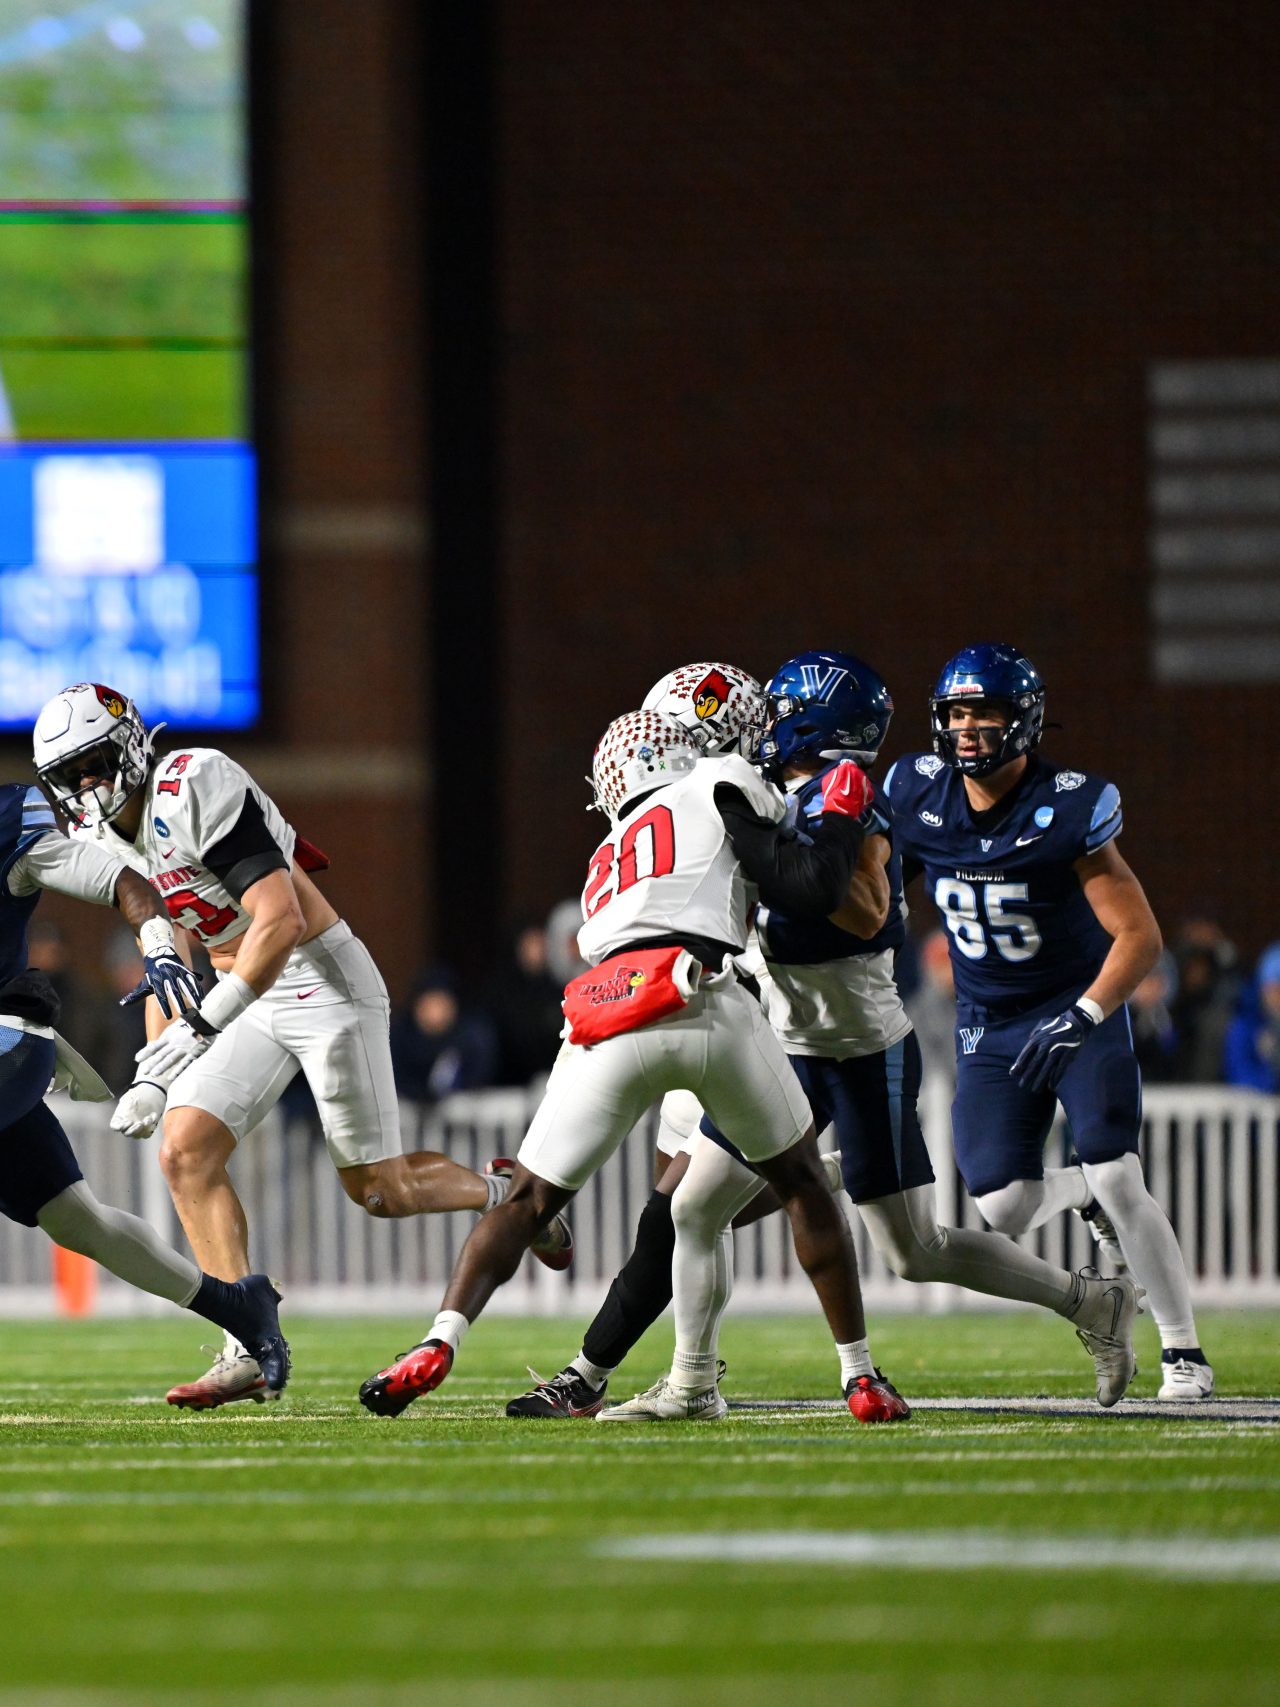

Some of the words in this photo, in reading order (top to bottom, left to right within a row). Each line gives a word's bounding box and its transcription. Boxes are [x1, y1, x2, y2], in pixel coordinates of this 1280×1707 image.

[800, 665, 848, 707] V
[157, 754, 193, 797] 13
[583, 804, 675, 923] 20
[980, 839, 992, 852] V
[157, 865, 202, 890] STATE
[935, 878, 1043, 962] 85
[959, 1026, 985, 1055] V
